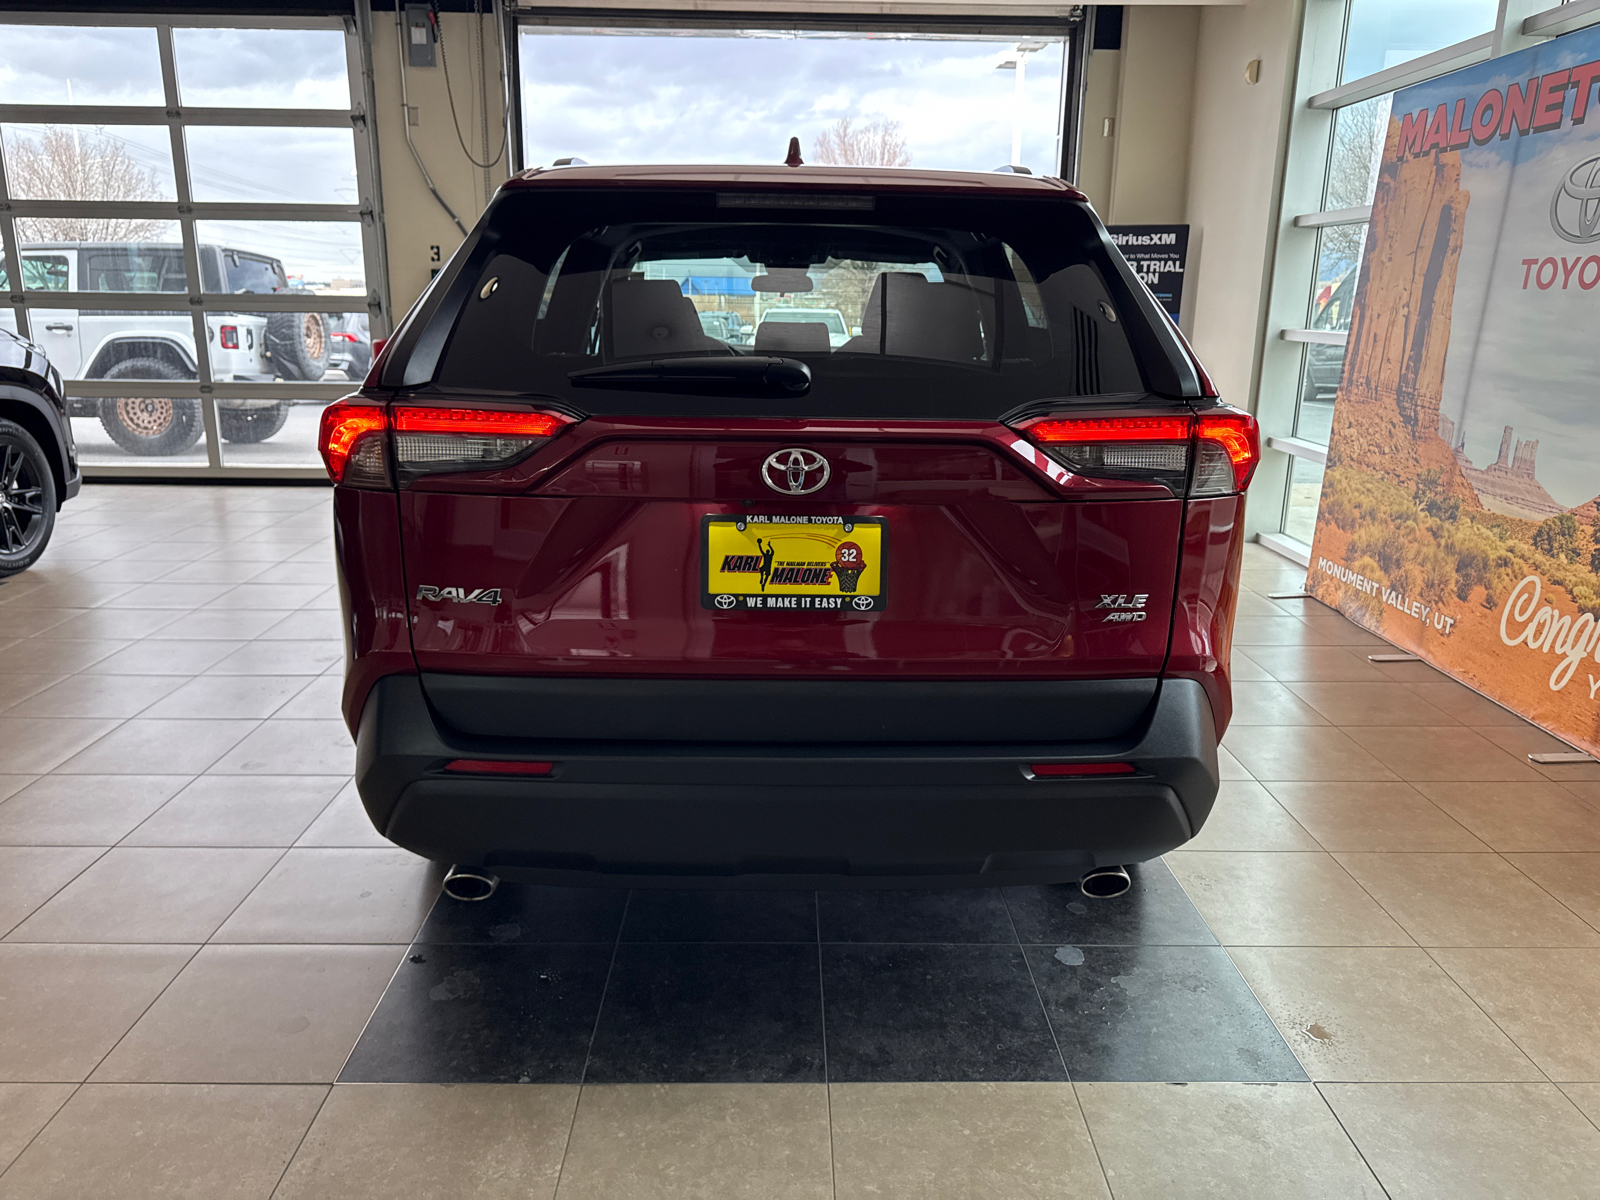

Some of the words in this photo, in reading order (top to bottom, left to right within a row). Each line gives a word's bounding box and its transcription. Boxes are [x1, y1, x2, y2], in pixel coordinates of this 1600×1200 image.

[1396, 60, 1600, 163] MALONET
[1109, 233, 1176, 245] SiriusXM
[430, 245, 441, 261] 3
[1140, 261, 1184, 272] TRIAL
[746, 515, 770, 523] KARL
[772, 516, 809, 524] MALONE
[811, 516, 843, 524] TOYOTA
[841, 549, 857, 562] 32
[720, 555, 763, 573] KARL
[769, 567, 833, 586] MALONE
[416, 584, 503, 606] RAV4
[1095, 594, 1149, 608] XLE
[1318, 556, 1379, 597] MONUMENT
[1381, 586, 1430, 627] VALLEY,
[1433, 612, 1454, 635] UT
[746, 597, 763, 608] WE
[767, 597, 797, 608] MAKE
[801, 597, 811, 608] IT
[815, 598, 842, 609] EASY
[1101, 611, 1147, 623] AWD
